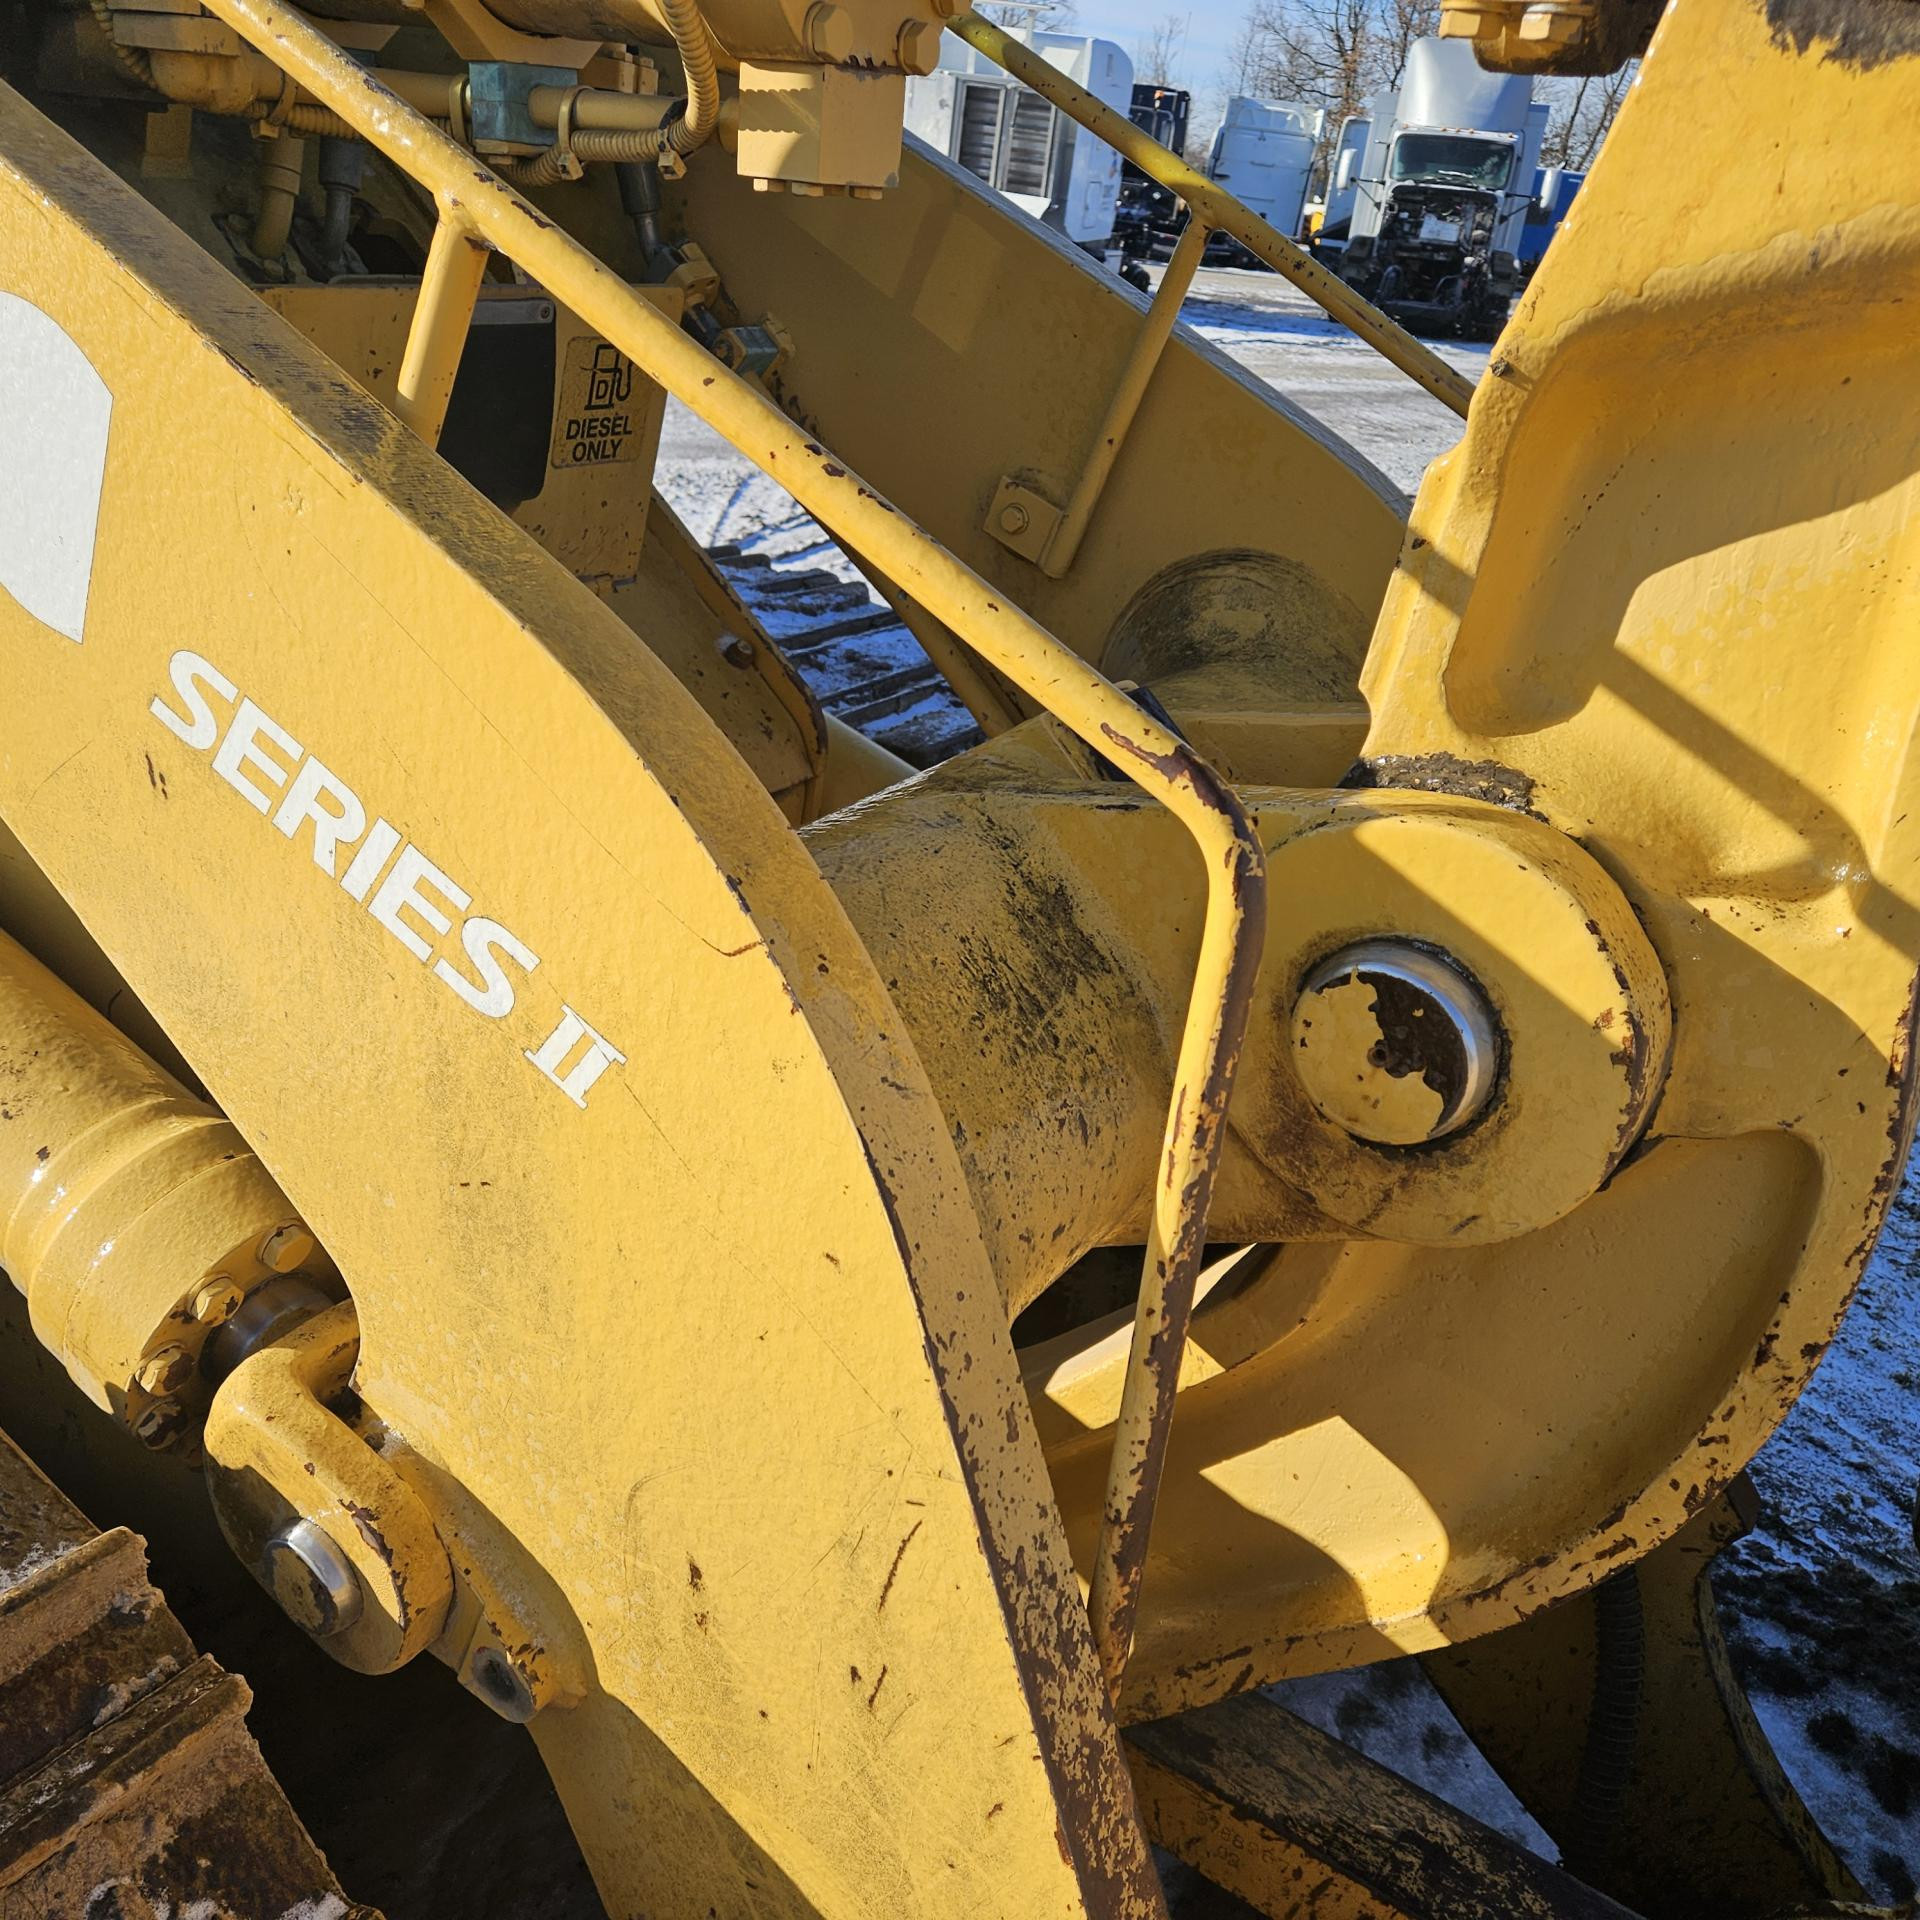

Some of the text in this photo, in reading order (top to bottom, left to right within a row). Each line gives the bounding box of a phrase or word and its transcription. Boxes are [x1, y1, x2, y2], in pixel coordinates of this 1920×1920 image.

[566, 415, 632, 440] DIESEL
[572, 438, 623, 462] ONLY
[149, 649, 628, 1110] SERIES II
